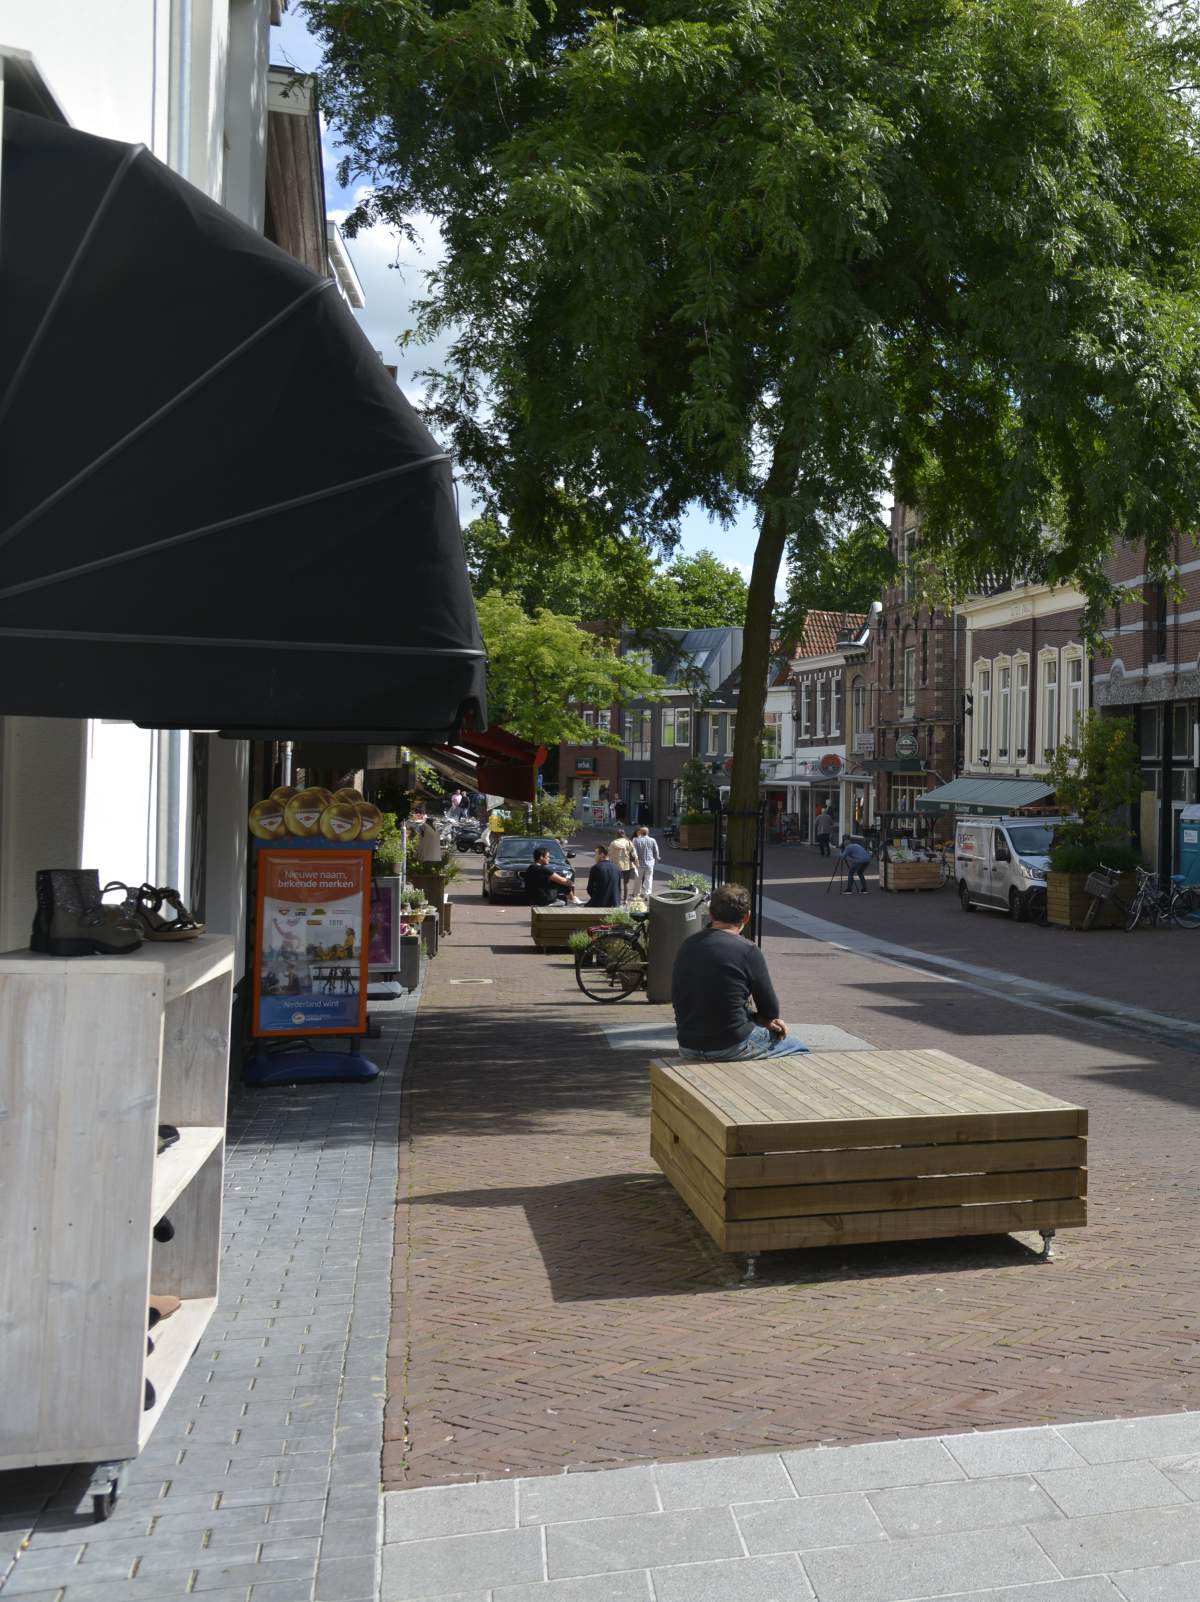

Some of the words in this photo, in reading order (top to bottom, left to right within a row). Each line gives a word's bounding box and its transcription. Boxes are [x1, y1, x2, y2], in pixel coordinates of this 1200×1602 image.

[285, 870, 318, 880] Nieuwe
[319, 871, 348, 881] naam,
[277, 879, 317, 889] bekende
[318, 879, 354, 889] merken
[283, 999, 323, 1009] Nederland
[323, 999, 340, 1008] wint
